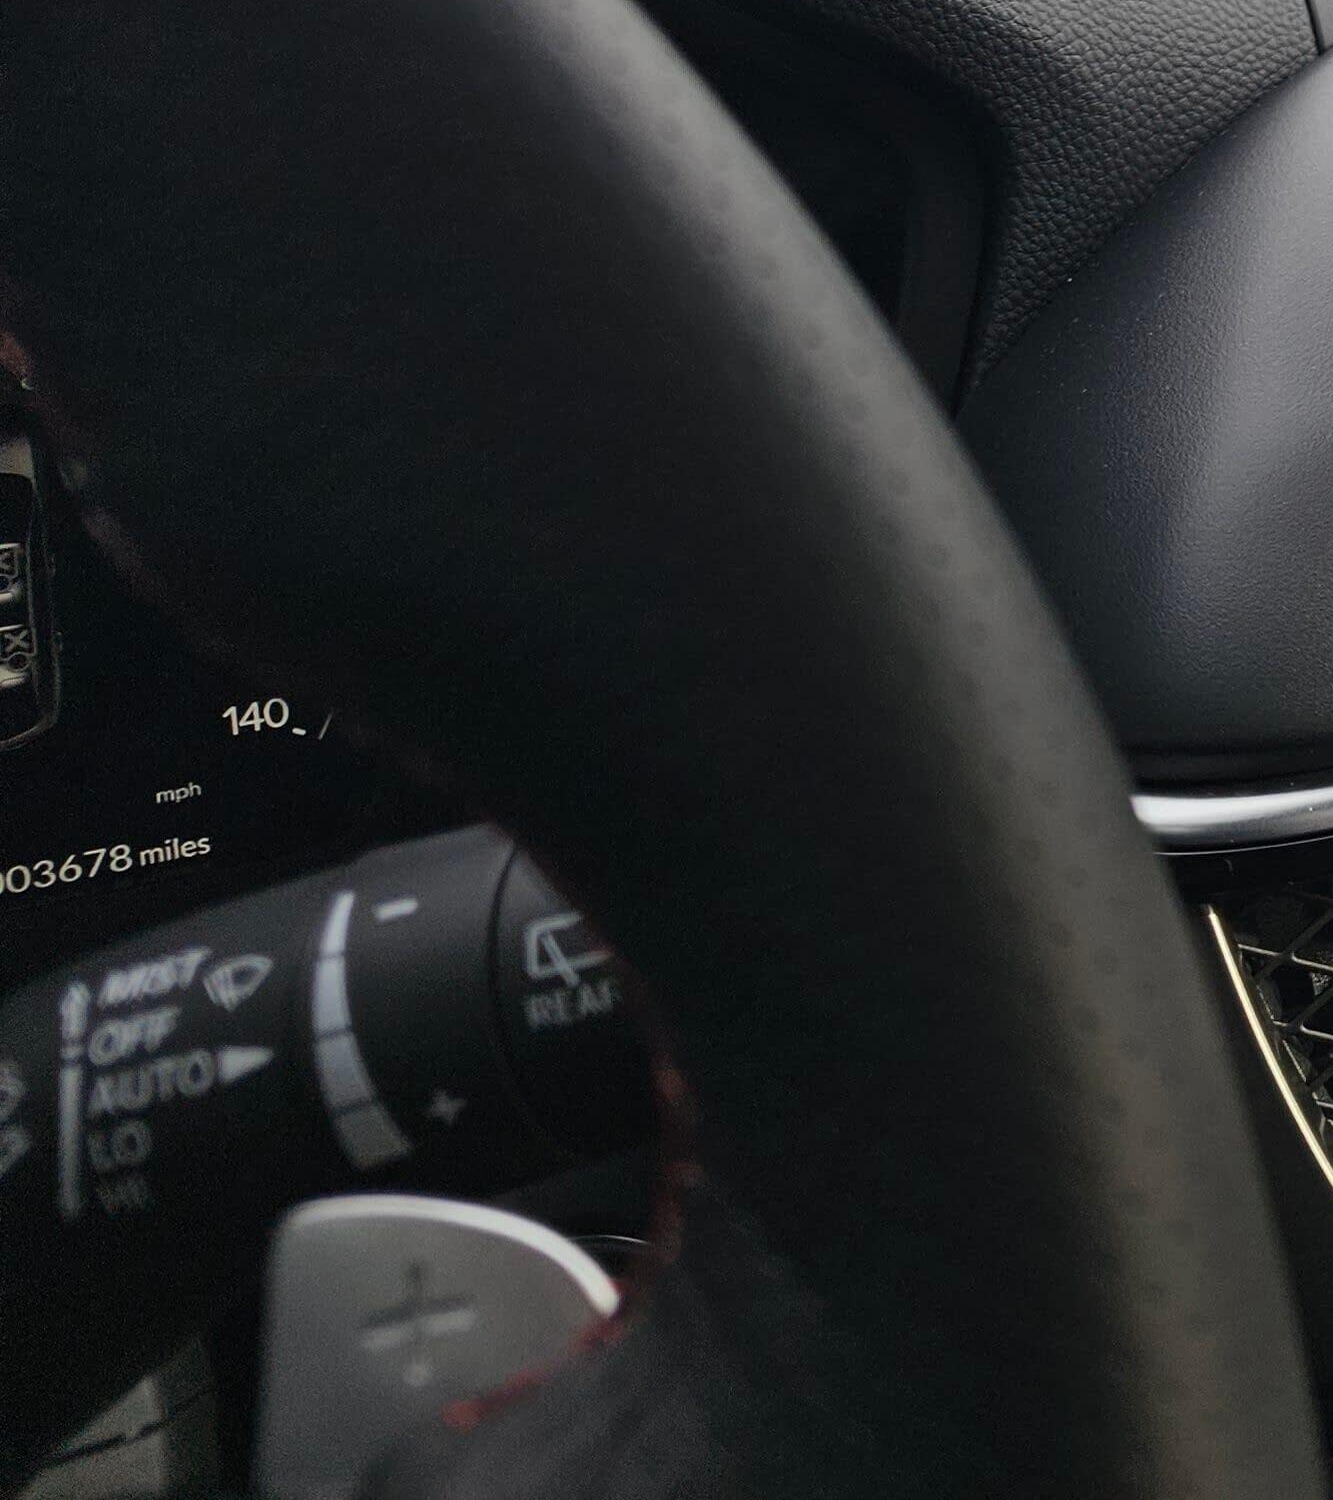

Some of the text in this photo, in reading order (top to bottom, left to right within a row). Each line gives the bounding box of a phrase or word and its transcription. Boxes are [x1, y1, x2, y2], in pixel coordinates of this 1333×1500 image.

[222, 697, 290, 736] 140
[155, 782, 202, 804] mph
[0, 837, 211, 894] 03678 miles
[88, 1050, 216, 1116] AUTO
